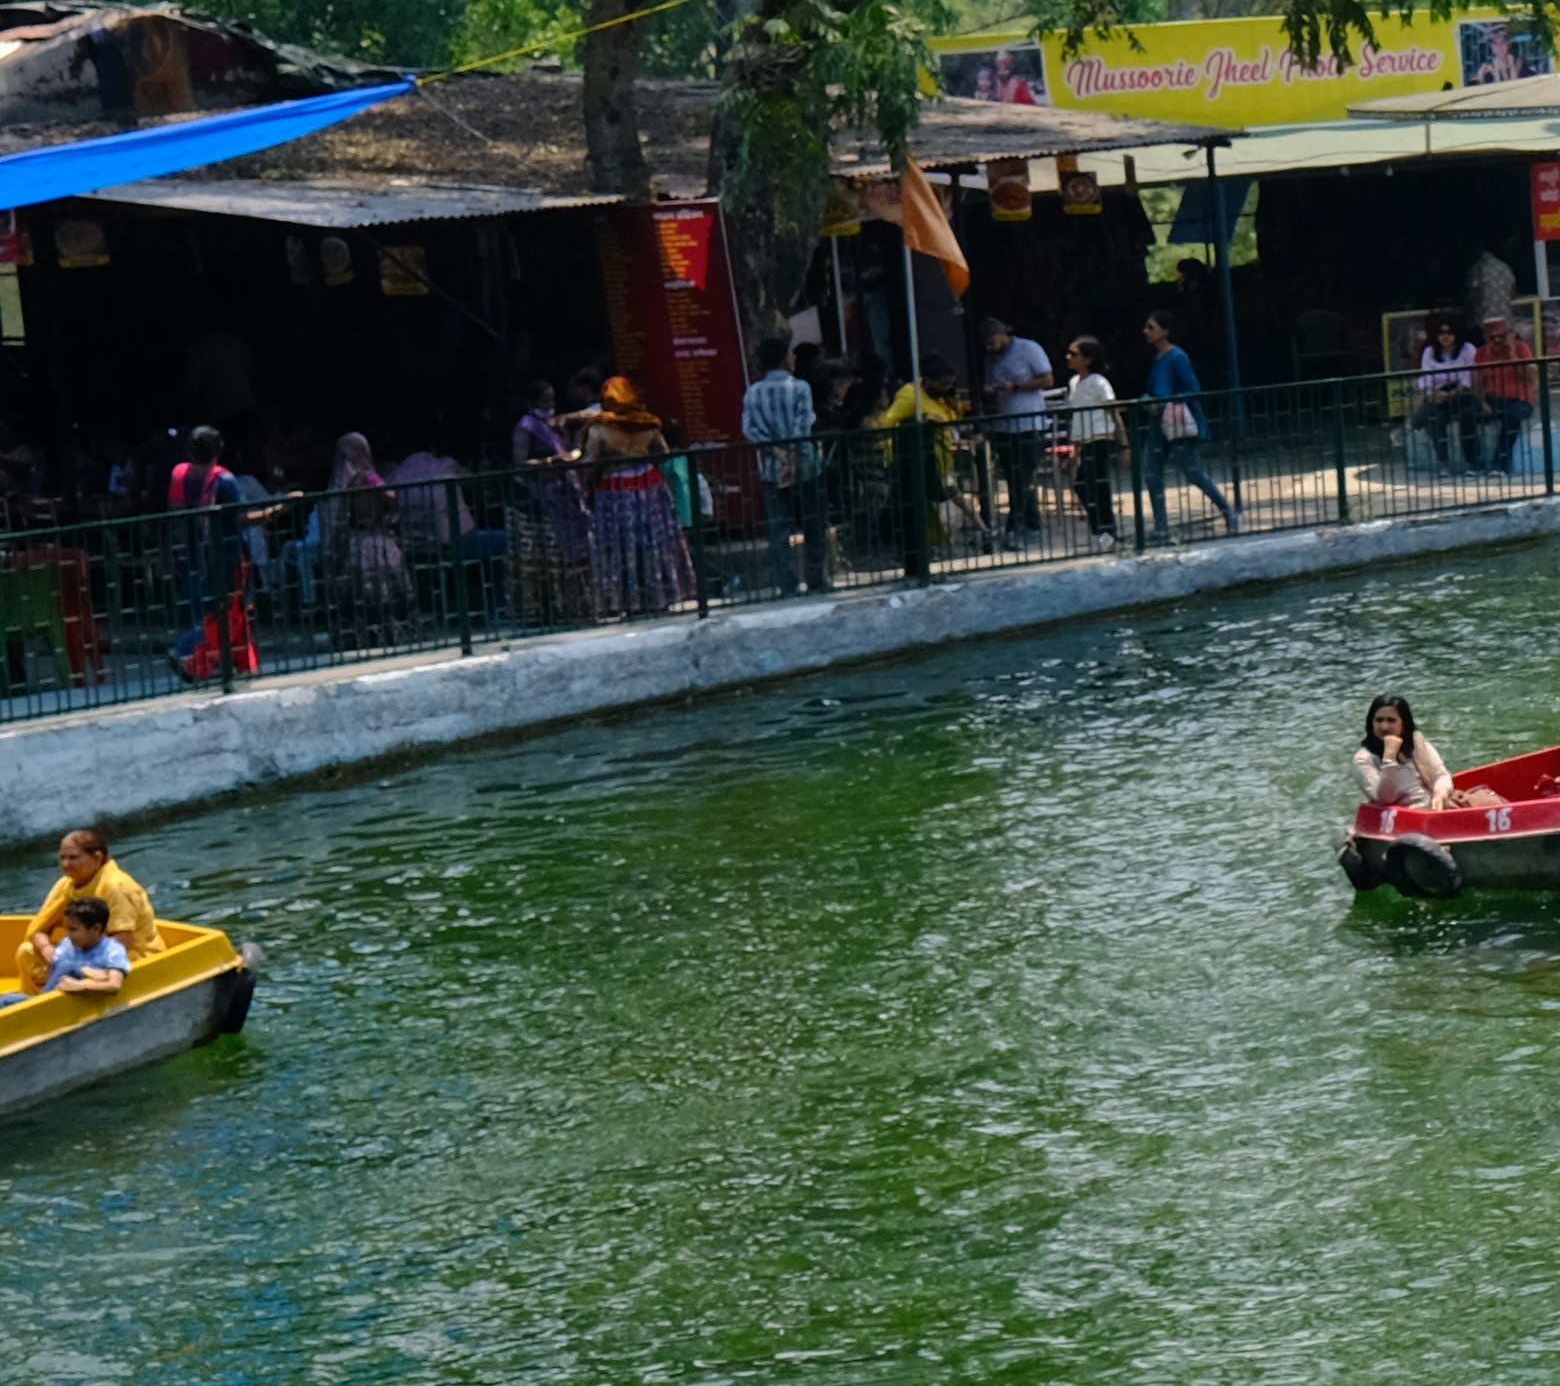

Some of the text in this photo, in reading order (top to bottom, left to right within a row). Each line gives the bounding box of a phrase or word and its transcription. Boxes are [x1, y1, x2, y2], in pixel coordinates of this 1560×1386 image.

[1065, 56, 1197, 99] Mussoorie
[1203, 45, 1271, 101] Jheel
[1359, 38, 1441, 79] Service
[1485, 806, 1513, 833] 16
